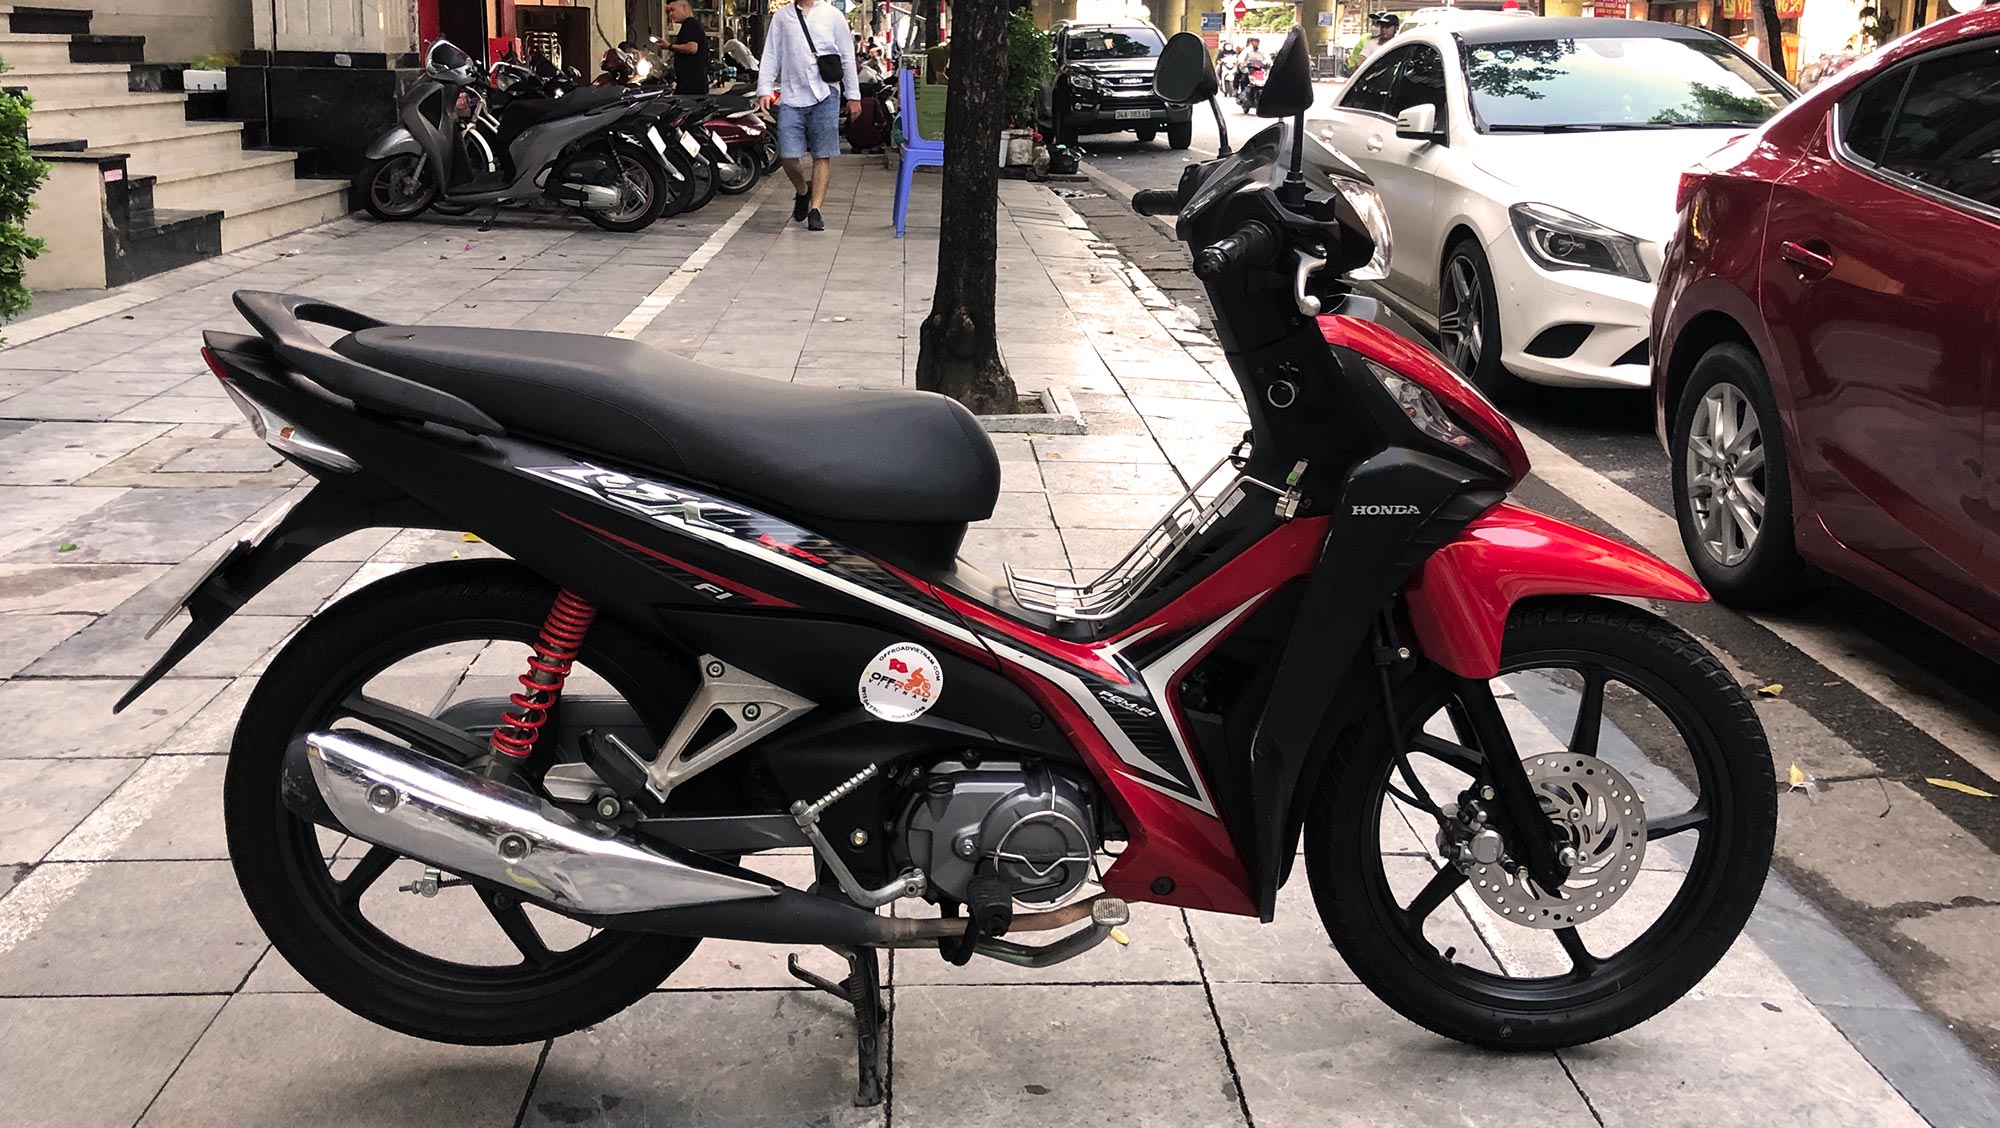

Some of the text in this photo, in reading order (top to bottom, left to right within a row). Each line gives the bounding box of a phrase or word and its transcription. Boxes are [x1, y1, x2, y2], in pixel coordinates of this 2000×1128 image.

[1351, 504, 1421, 515] HONDA
[694, 582, 734, 600] FI
[878, 645, 941, 682] OFFROADVIETNAM.COM
[868, 678, 928, 703] VIETNAM
[871, 672, 931, 698] OFFROAD
[1098, 690, 1156, 717] PGM-FI
